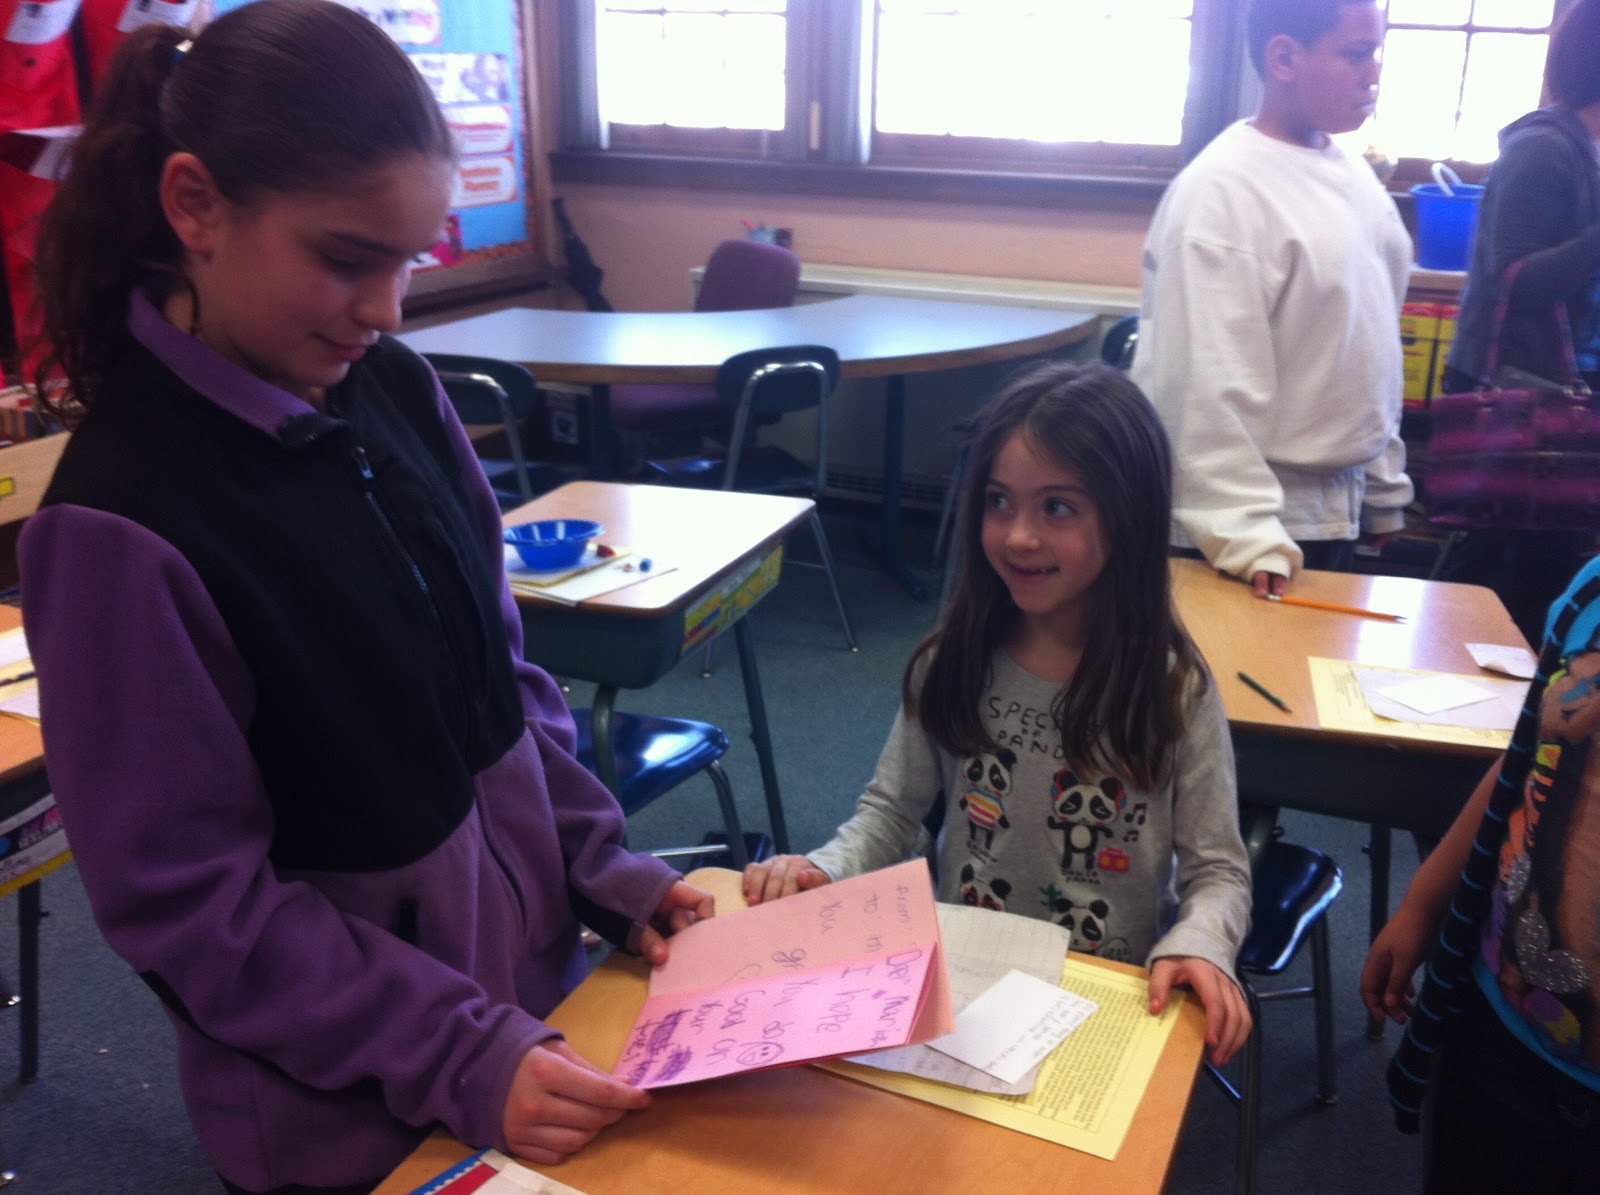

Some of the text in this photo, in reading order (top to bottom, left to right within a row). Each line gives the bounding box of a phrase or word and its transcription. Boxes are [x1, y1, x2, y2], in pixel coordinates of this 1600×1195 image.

[988, 696, 1050, 730] SPEC
[997, 729, 1065, 760] PAND
[816, 987, 871, 1034] hope
